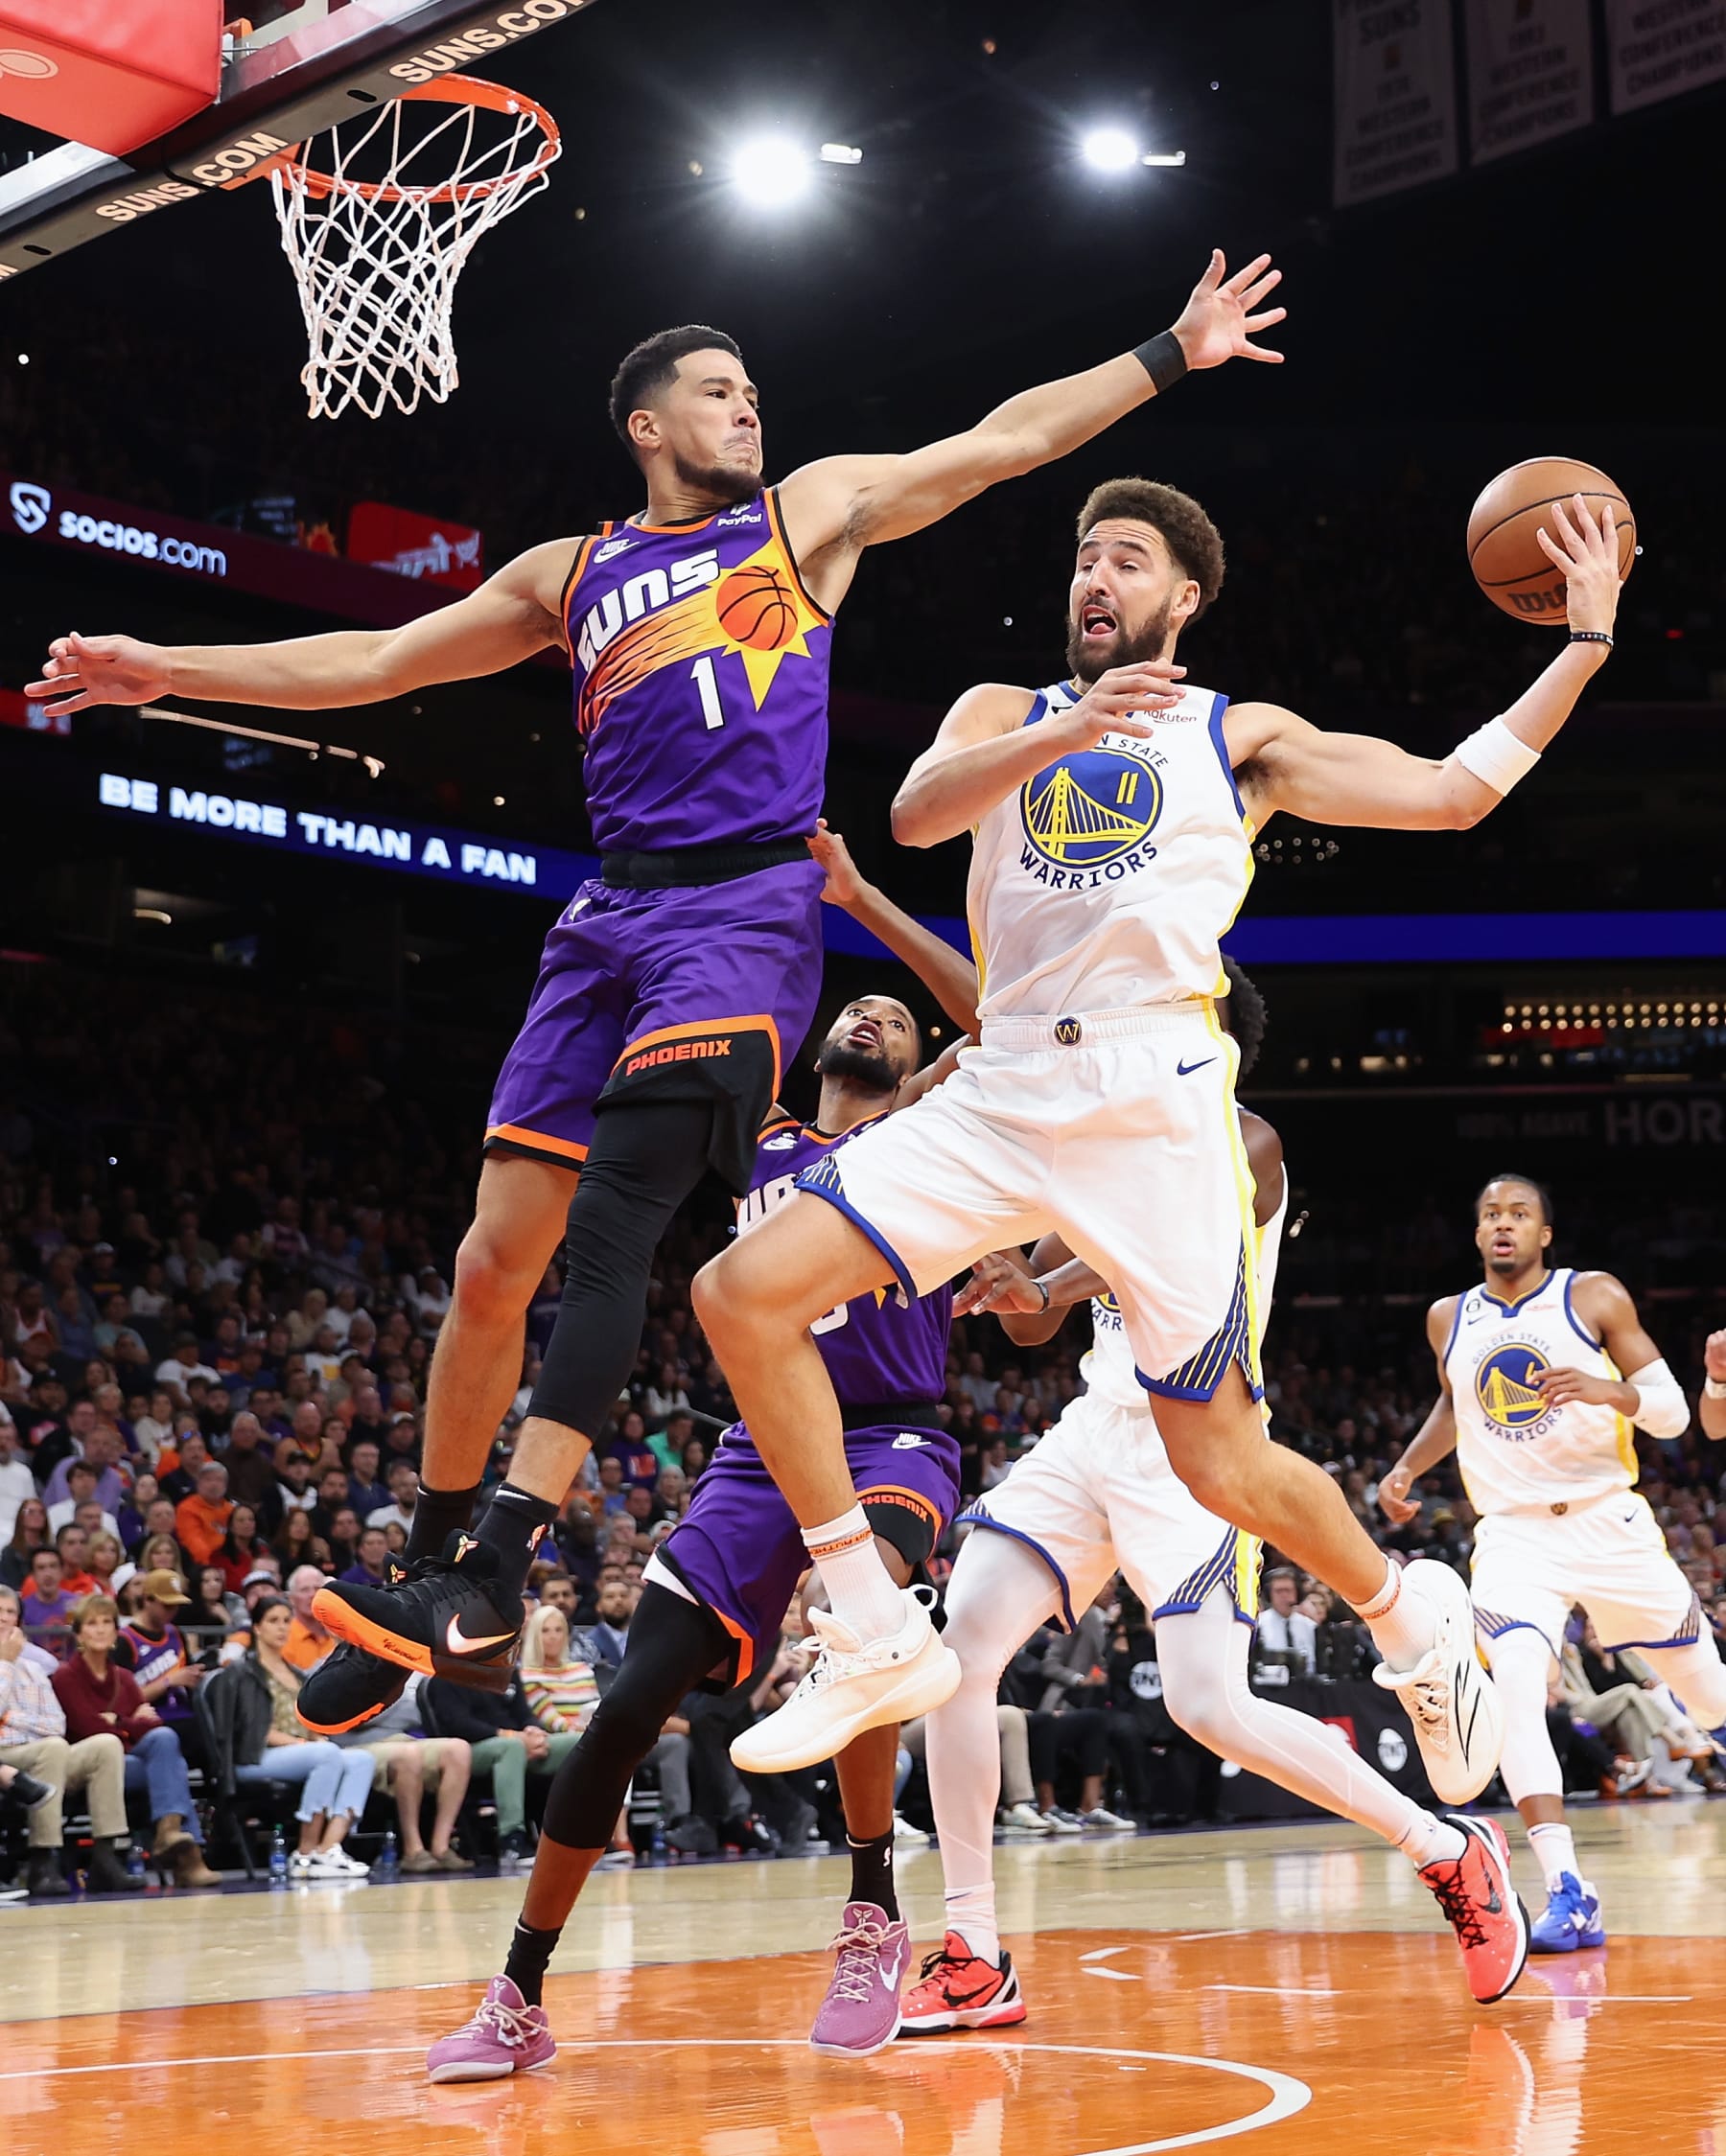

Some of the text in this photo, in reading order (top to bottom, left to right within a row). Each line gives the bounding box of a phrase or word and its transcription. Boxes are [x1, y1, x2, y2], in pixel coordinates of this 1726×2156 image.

[388, 0, 584, 83] SUNS.CO
[96, 131, 289, 221] SUNS.COM
[717, 513, 762, 527] PayPal
[690, 656, 725, 730] 1
[1118, 738, 1169, 768] STATE
[1115, 770, 1139, 805] 11
[100, 773, 537, 884] BE MORE THAN A FAN
[1020, 841, 1158, 890] WARRIORS
[626, 1039, 732, 1077] PHOENIX
[1473, 1333, 1551, 1364] GOLDEN STATE
[1484, 1407, 1563, 1443] WARRIORS
